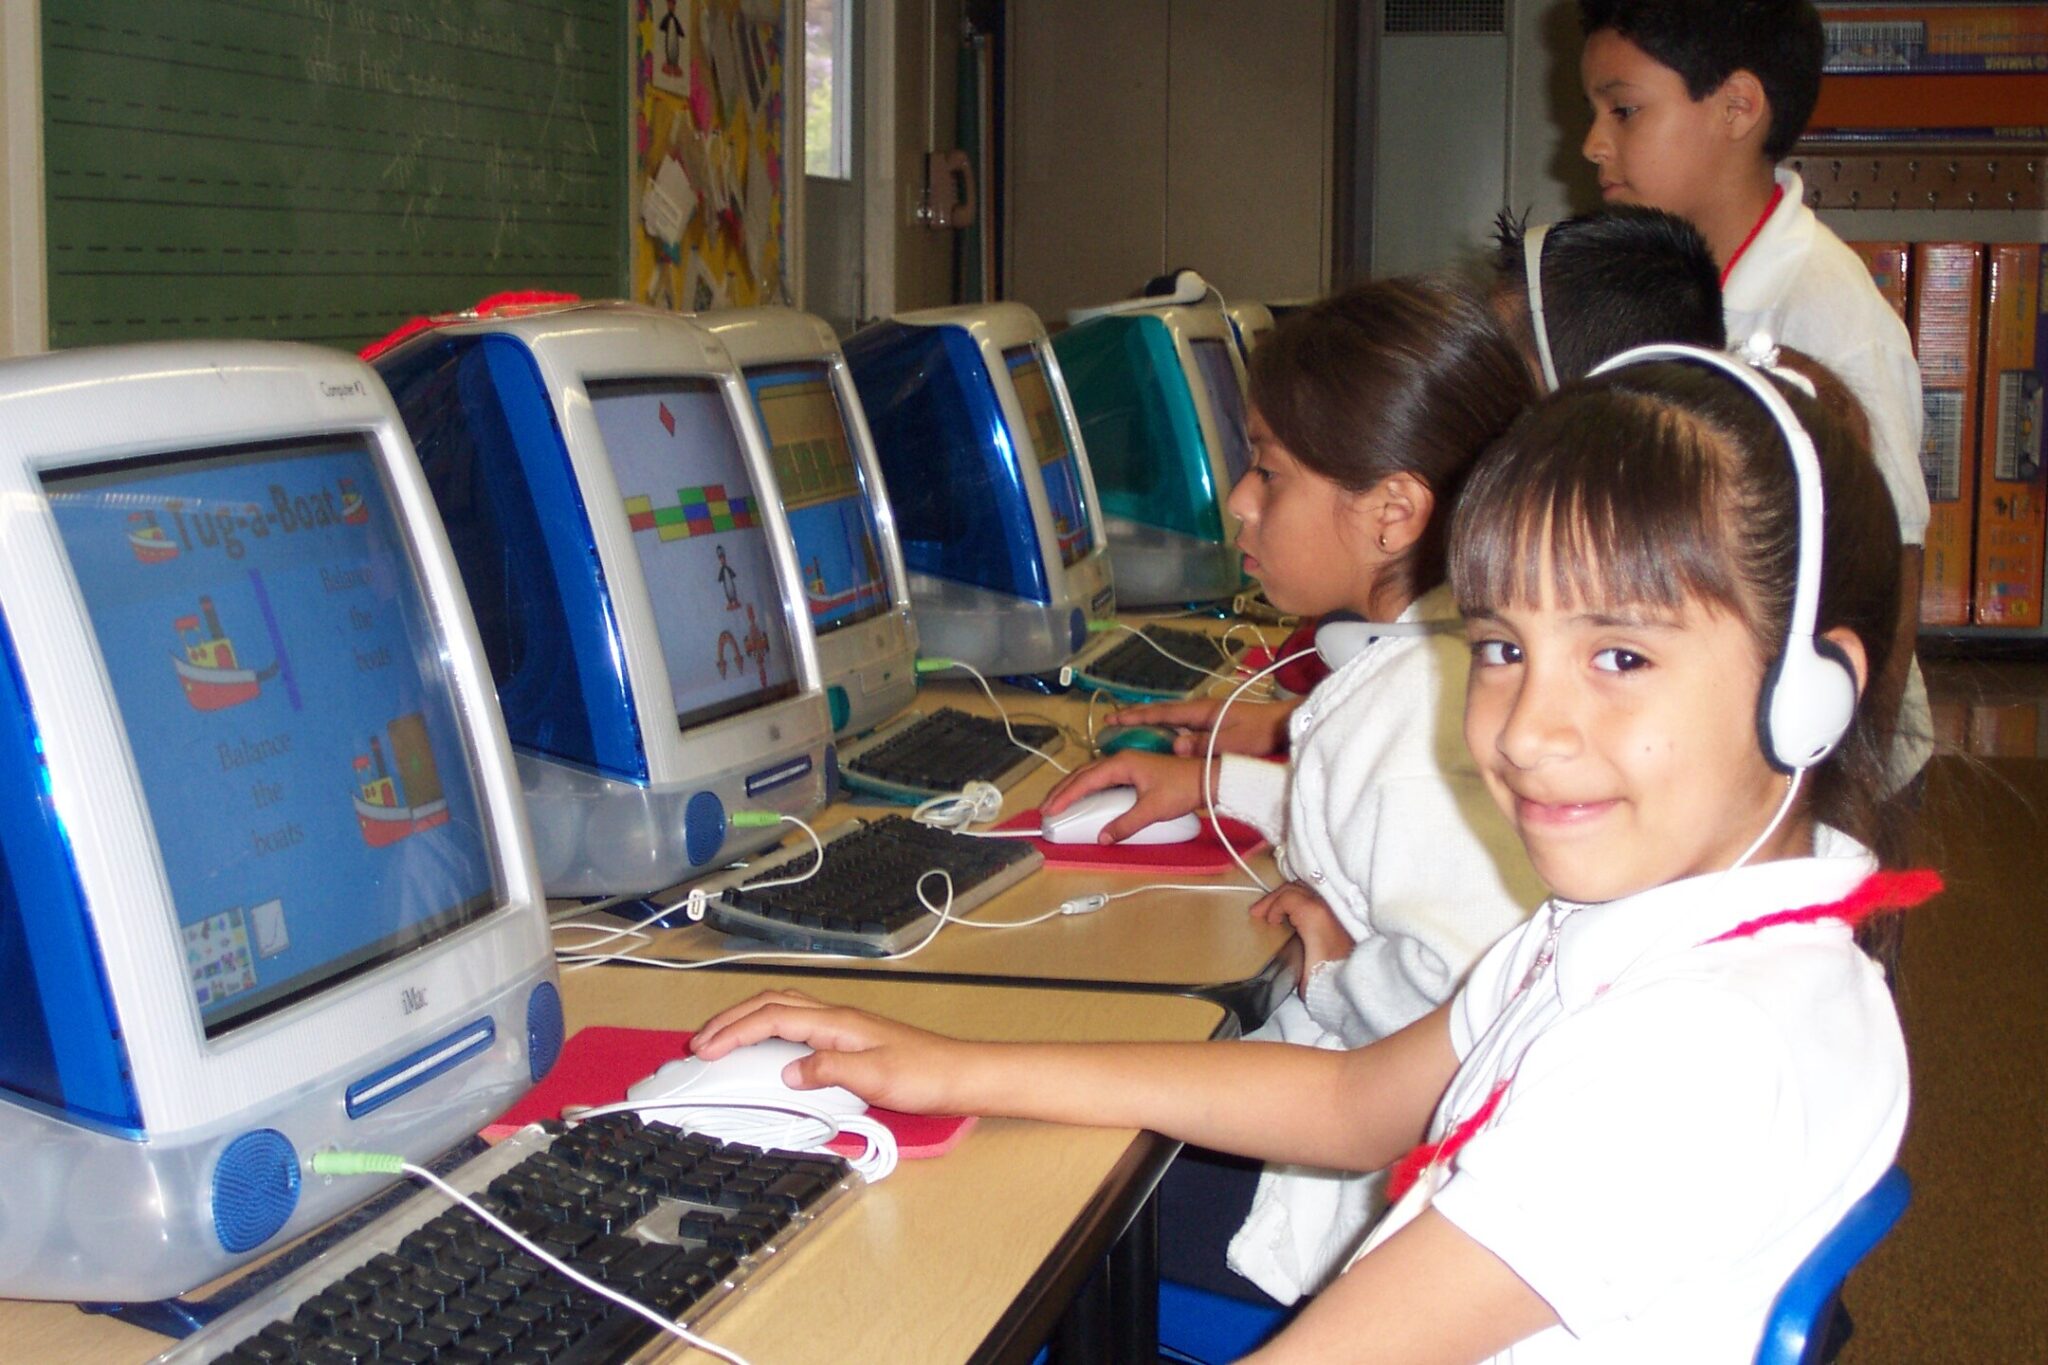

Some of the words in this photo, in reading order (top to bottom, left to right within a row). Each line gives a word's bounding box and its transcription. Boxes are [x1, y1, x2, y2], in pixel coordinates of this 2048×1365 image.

[166, 483, 342, 560] Tug-a-Boat
[216, 733, 291, 772] Balance
[251, 778, 284, 809] the
[251, 823, 305, 858] boats
[402, 986, 428, 1015] iMac
